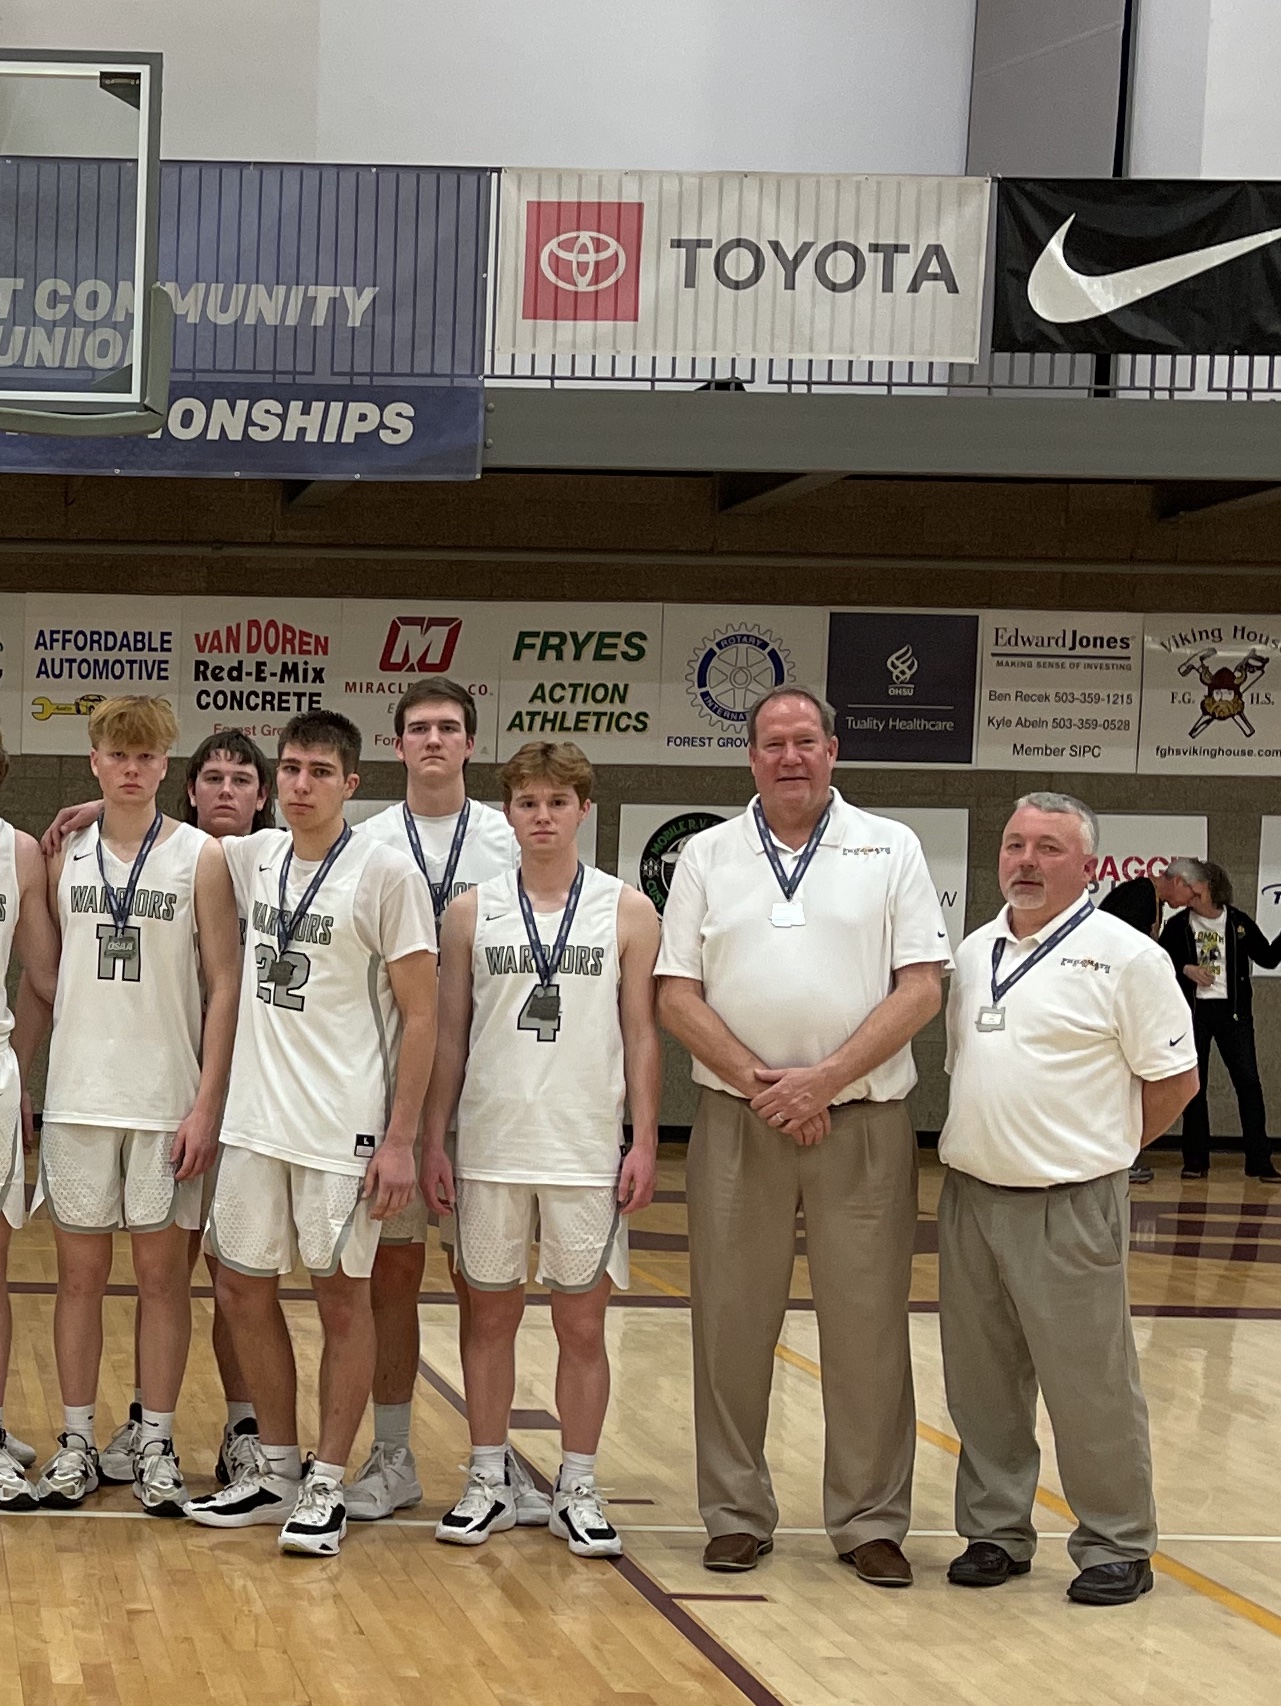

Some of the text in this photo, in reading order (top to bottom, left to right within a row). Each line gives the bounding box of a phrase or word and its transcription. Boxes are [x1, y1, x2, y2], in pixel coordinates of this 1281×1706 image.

[669, 237, 960, 296] TOYOTA
[34, 629, 173, 653] AFFORDABLE
[194, 618, 330, 657] VAN DOREN
[512, 630, 649, 663] FRYES
[720, 634, 765, 648] ROTARY
[993, 627, 1131, 651] Edward Jones
[1160, 627, 1223, 653] Viking
[36, 657, 169, 681] AUTOMOTIVE
[194, 659, 326, 684] Red-E-Mix
[996, 660, 1132, 671] MAKING SENSE OF INVESTING
[196, 689, 323, 713] CONCRETE
[528, 682, 630, 705] ACTION
[888, 687, 915, 697] OHSU
[989, 690, 1011, 702] Ben
[1014, 691, 1051, 703] Recek
[1170, 692, 1196, 704] F.G.
[506, 711, 651, 733] ATHLETICS
[846, 716, 955, 732] Tuality Healthcare
[987, 716, 1013, 730] Kyle
[1051, 718, 1131, 731] 503-359-0528
[667, 736, 750, 749] FOREST GROV
[1012, 743, 1102, 758] Member SIPC
[651, 820, 687, 856] MOBILE
[107, 942, 134, 951] OSAA
[517, 984, 562, 1043] 4
